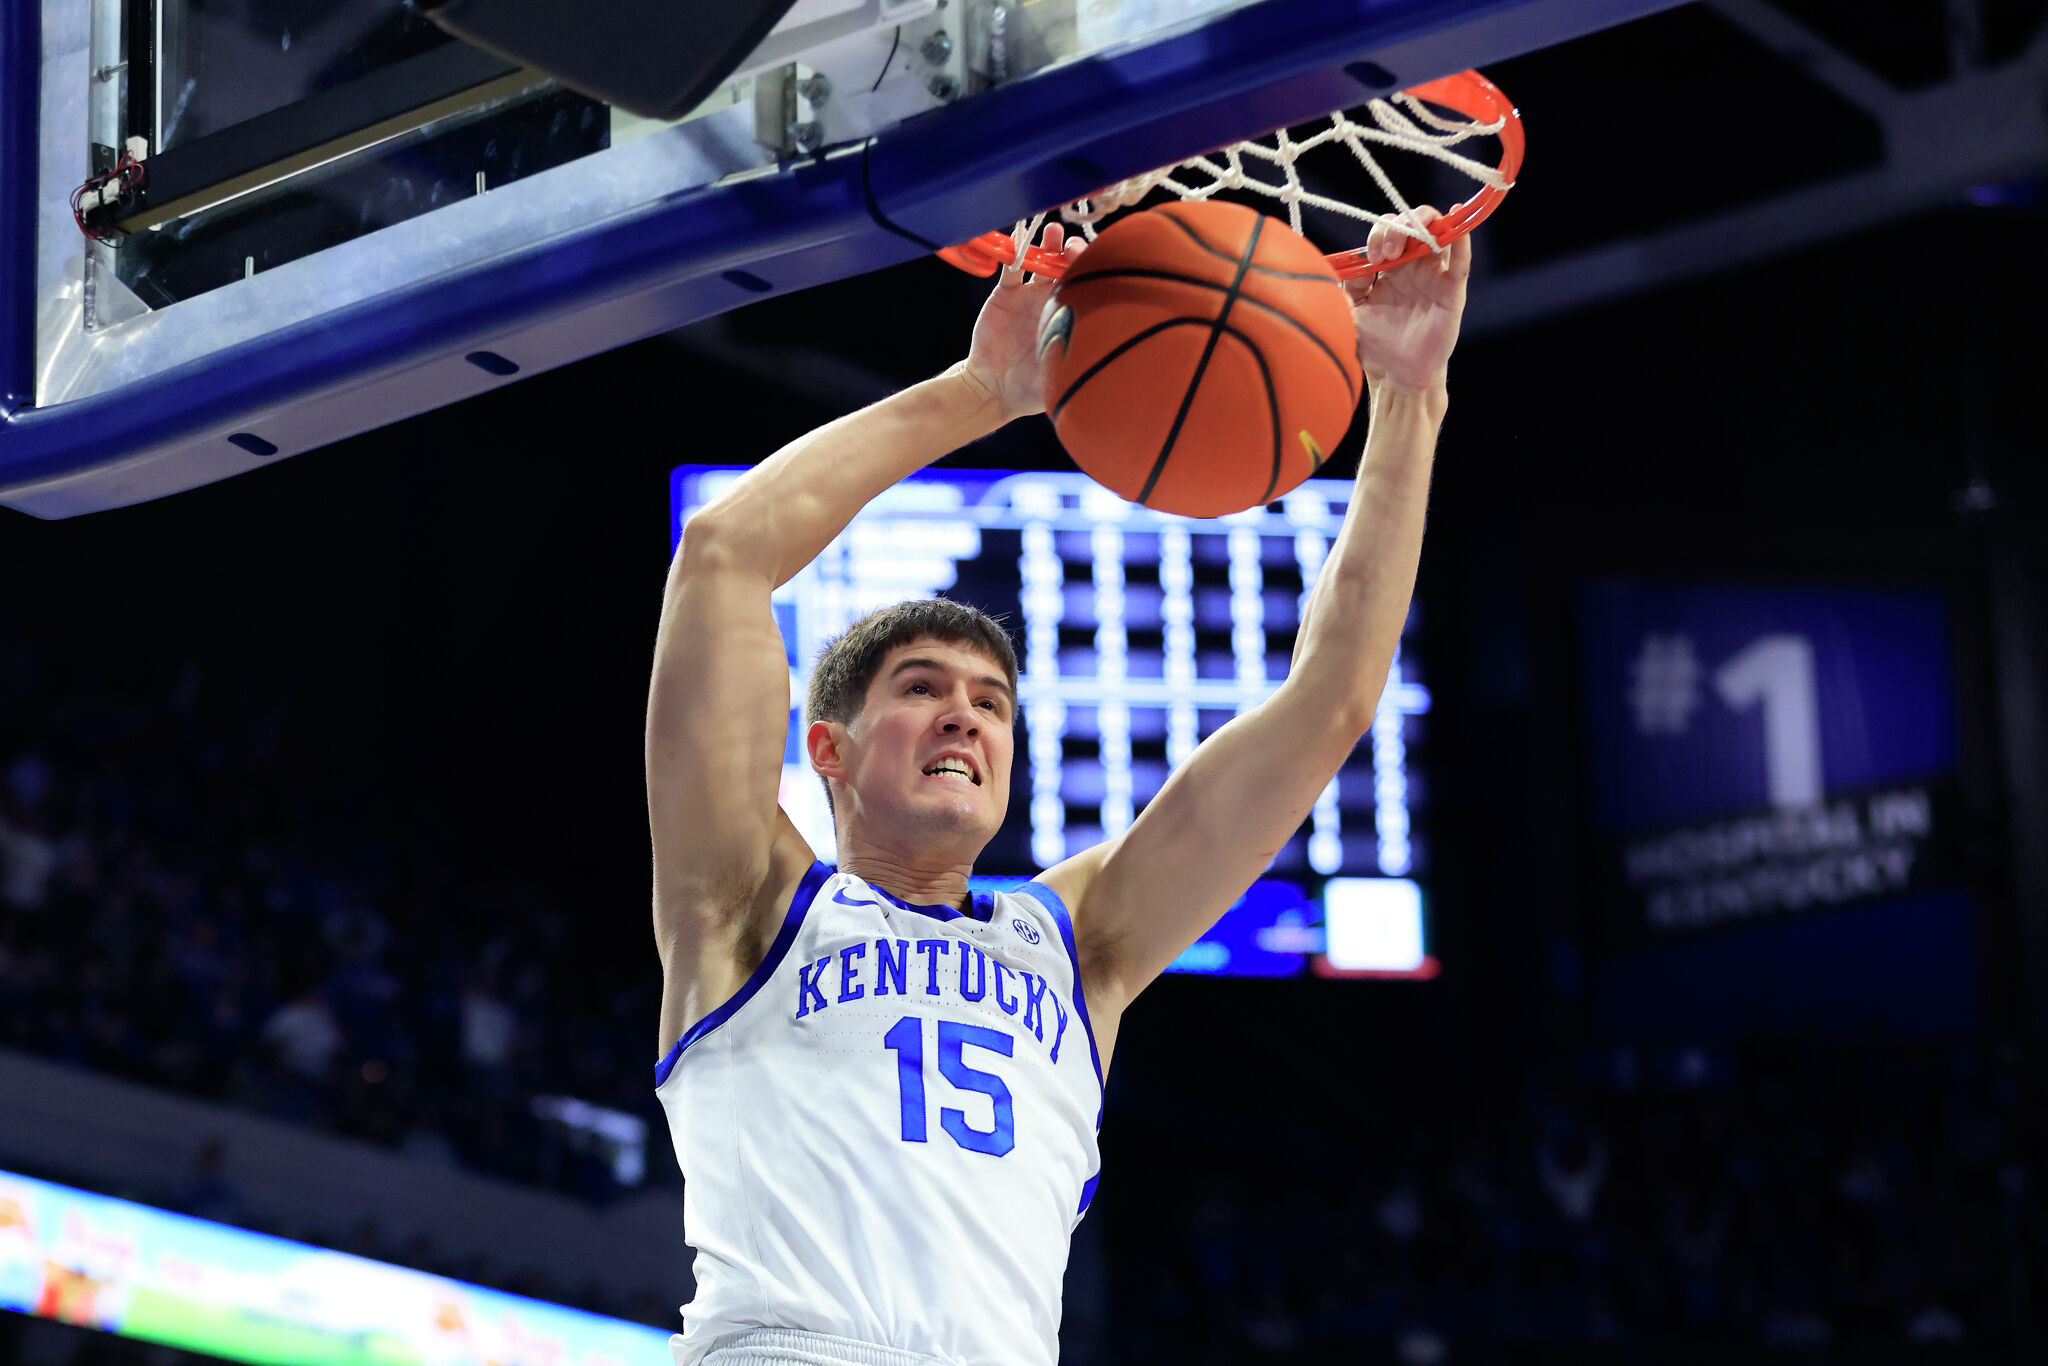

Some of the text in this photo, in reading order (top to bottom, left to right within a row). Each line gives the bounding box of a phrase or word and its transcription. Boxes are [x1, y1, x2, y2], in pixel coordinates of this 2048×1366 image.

[1629, 632, 1825, 806] #1
[1627, 790, 1931, 882] HOSPITAL IN
[1649, 845, 1914, 928] KENTUCKY
[1013, 919, 1040, 945] SEC
[796, 939, 1068, 1064] KENTUCKY
[884, 1016, 1015, 1158] 15
